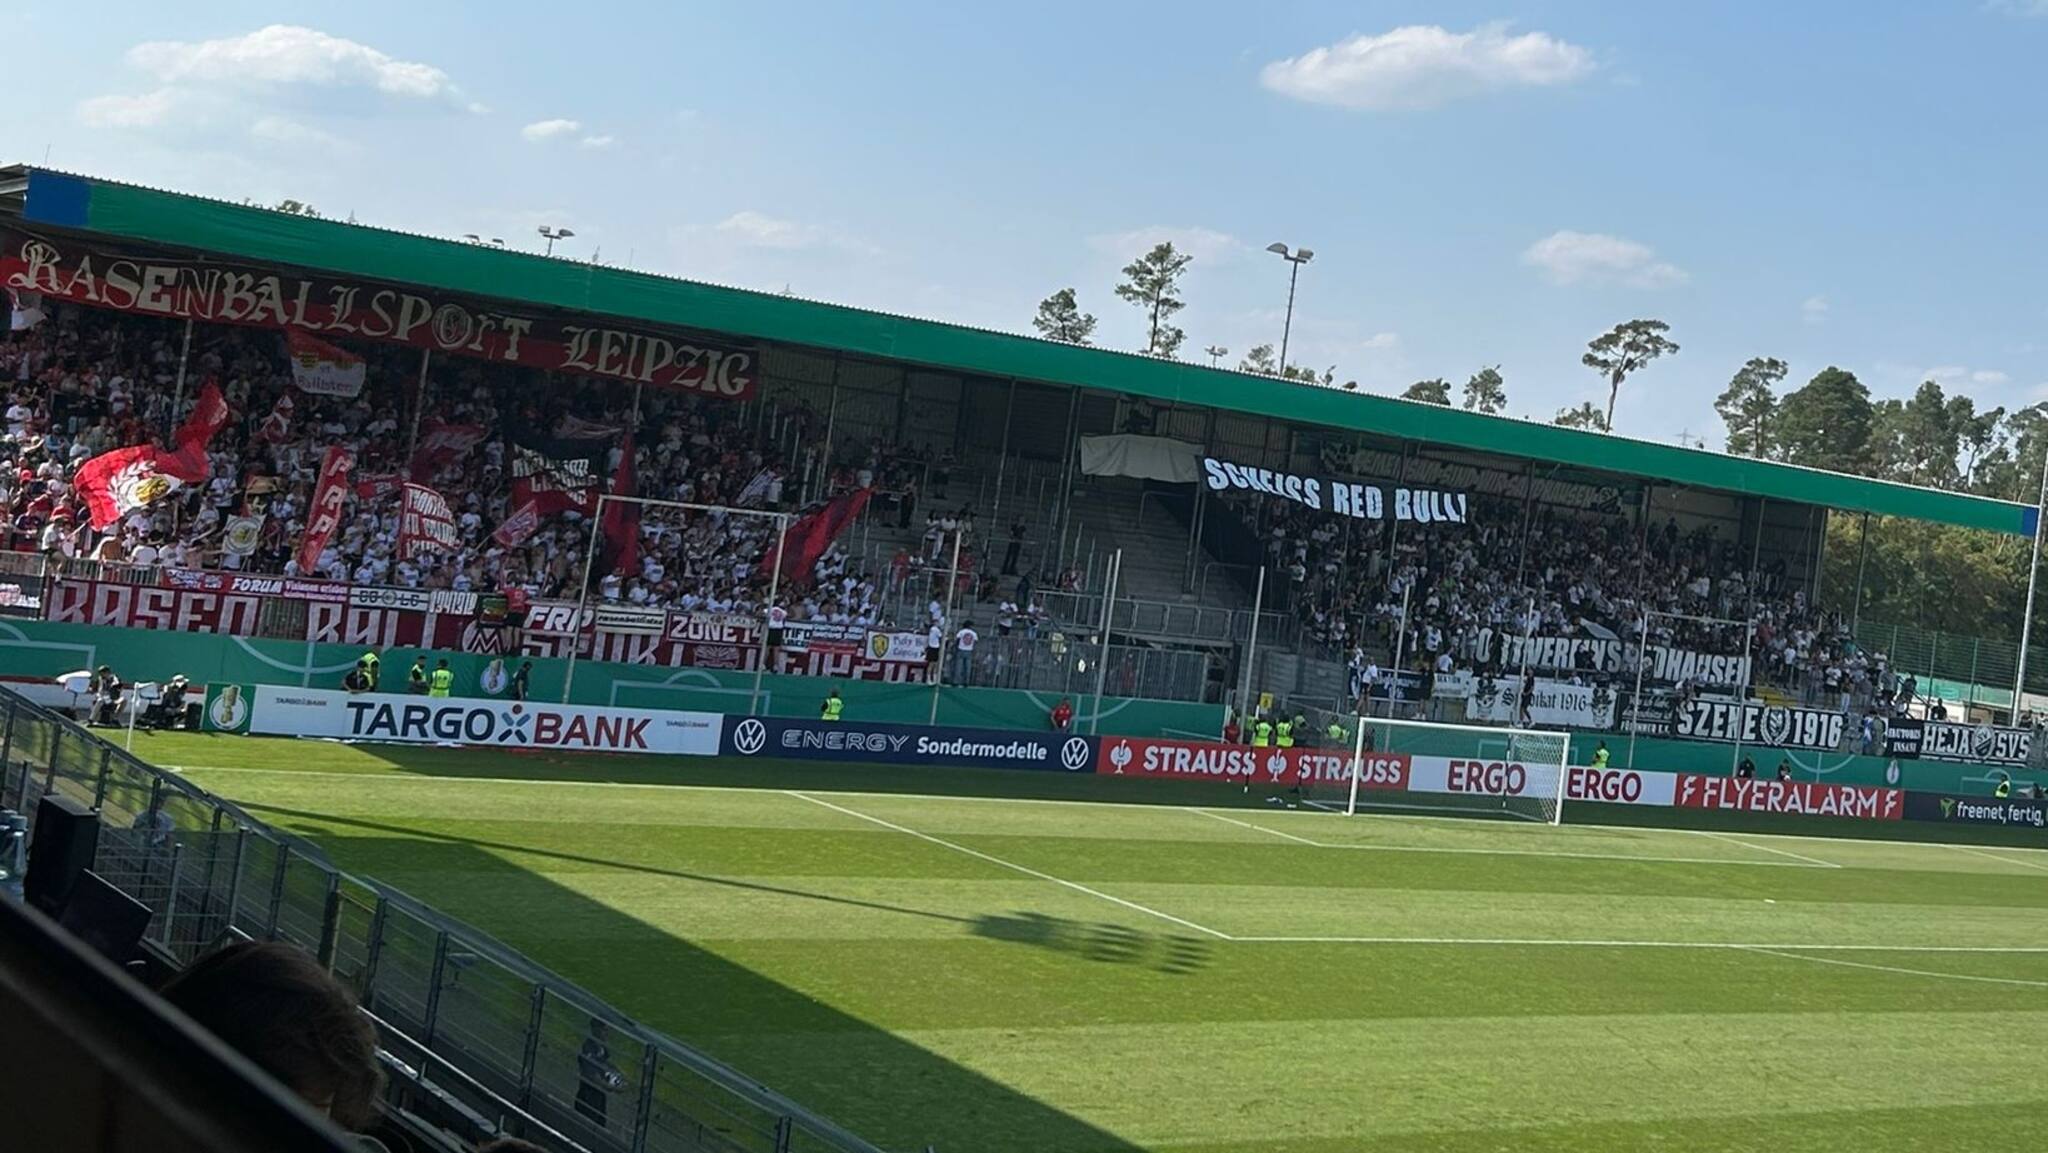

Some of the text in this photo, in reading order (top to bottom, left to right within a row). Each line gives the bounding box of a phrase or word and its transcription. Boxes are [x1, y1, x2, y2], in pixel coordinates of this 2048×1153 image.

[561, 326, 750, 395] LEIPZIG
[1204, 458, 1466, 523] SCHEISS RED BULL!
[231, 577, 283, 594] FORUM
[524, 606, 594, 633] FRP
[671, 615, 737, 642] ZONE
[1502, 687, 1587, 711] Sdikat 1916
[1677, 700, 1759, 741] SZENE
[1793, 711, 1843, 749] 1916
[782, 728, 1047, 760] ENERGY Sondermodelle
[1921, 724, 1970, 755] HEJA
[1995, 733, 2031, 760] SVS
[1144, 745, 1256, 776] STRAUSS
[1298, 755, 1401, 784] STRAUSS
[1447, 760, 1526, 795] ERGO
[1567, 768, 1642, 802] ERGO
[1703, 777, 1878, 818] FLYERALARM
